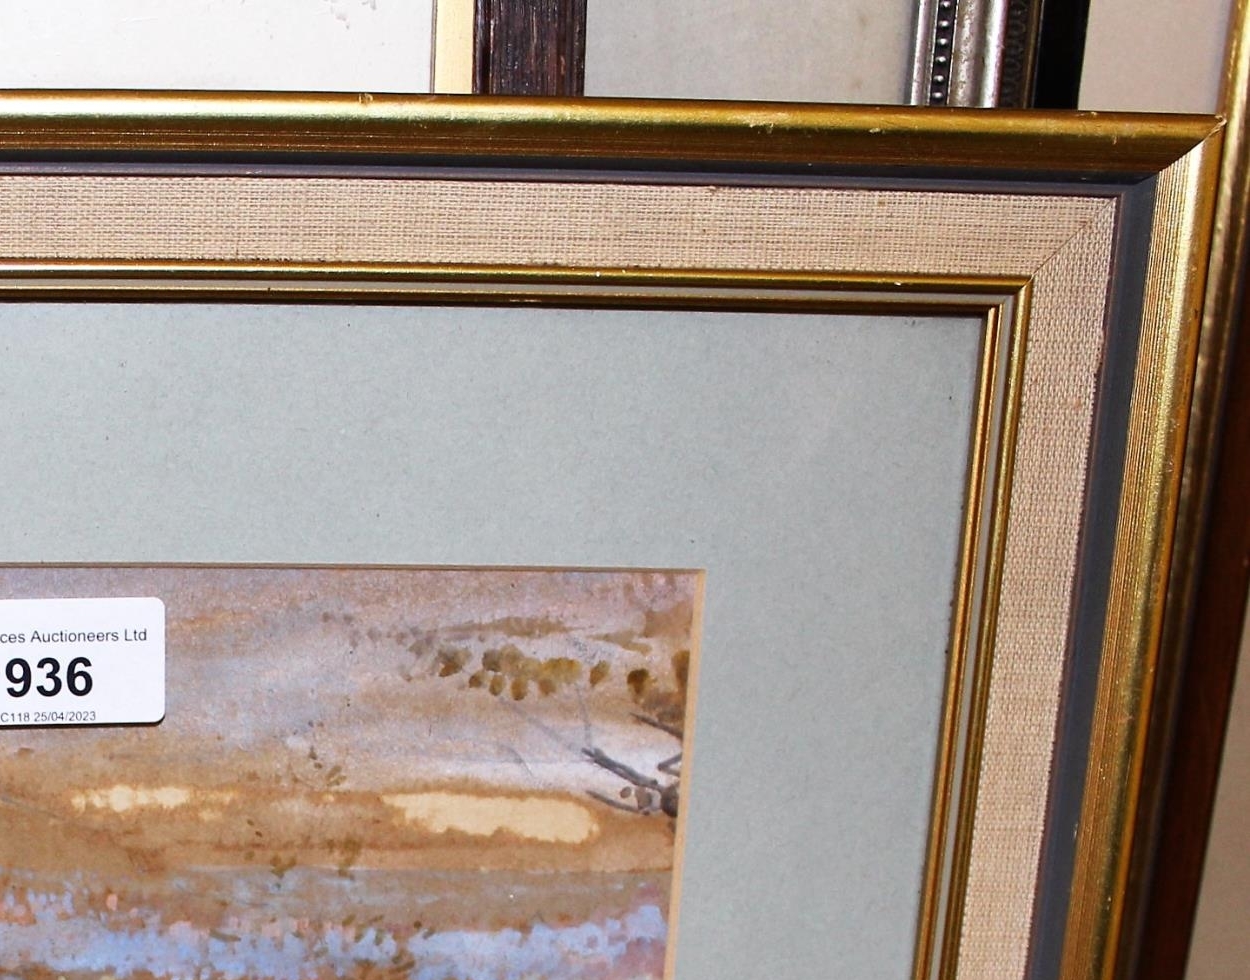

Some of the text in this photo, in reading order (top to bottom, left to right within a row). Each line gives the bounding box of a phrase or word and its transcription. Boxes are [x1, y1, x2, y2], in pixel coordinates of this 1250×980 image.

[30, 629, 119, 643] Auctioneers
[124, 628, 148, 642] Ltd
[4, 656, 94, 698] 936
[0, 710, 97, 723] C118 25/04/2023
